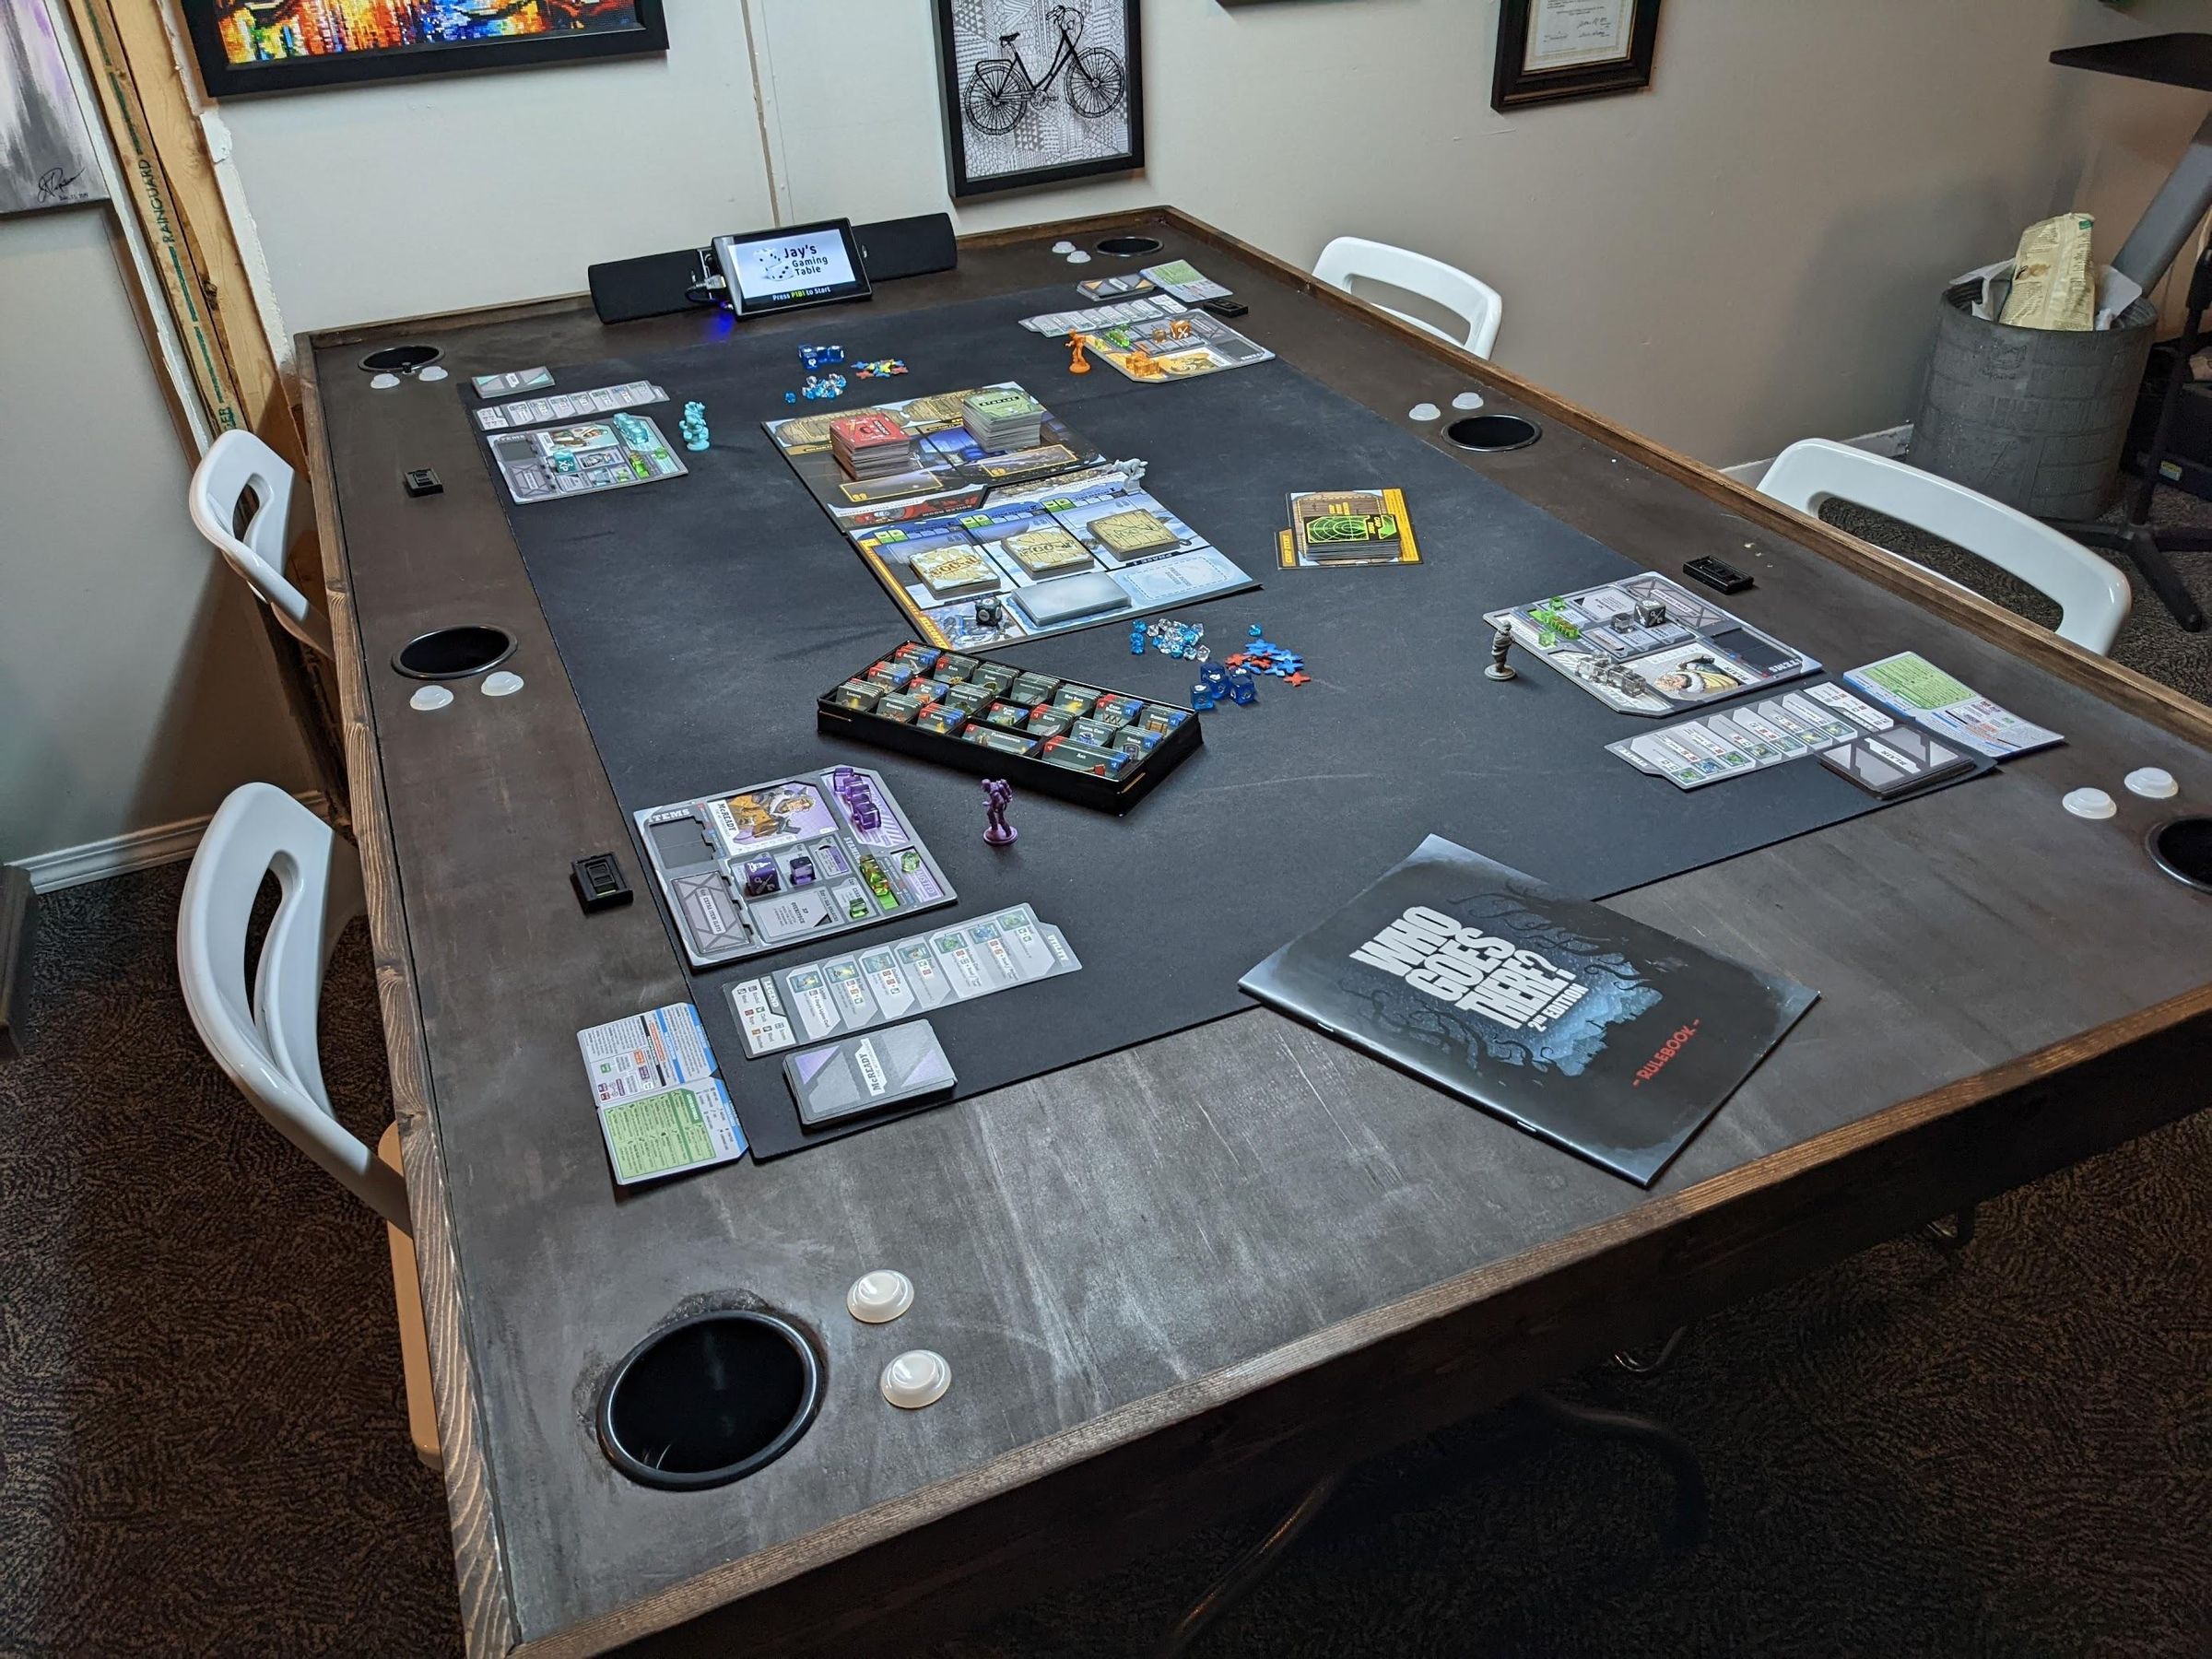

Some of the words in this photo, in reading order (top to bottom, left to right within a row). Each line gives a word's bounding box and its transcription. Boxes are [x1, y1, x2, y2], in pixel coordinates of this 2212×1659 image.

[138, 159, 178, 242] RAINGUARD
[783, 244, 818, 259] Jay's
[792, 256, 829, 268] Gaming
[794, 266, 821, 276] Table
[772, 292, 791, 300] Press
[814, 286, 831, 295] Start
[716, 802, 737, 832] McREADY
[1046, 934, 1068, 961] UTILITY
[1349, 905, 1463, 979] WHO
[1406, 927, 1516, 1003] GOES
[763, 980, 780, 1007] LEGEND
[1456, 949, 1578, 1030] THERE?
[1546, 984, 1590, 1019] EDITION
[1637, 1023, 1697, 1083] RULEBOOK
[859, 1053, 882, 1091] McREADY
